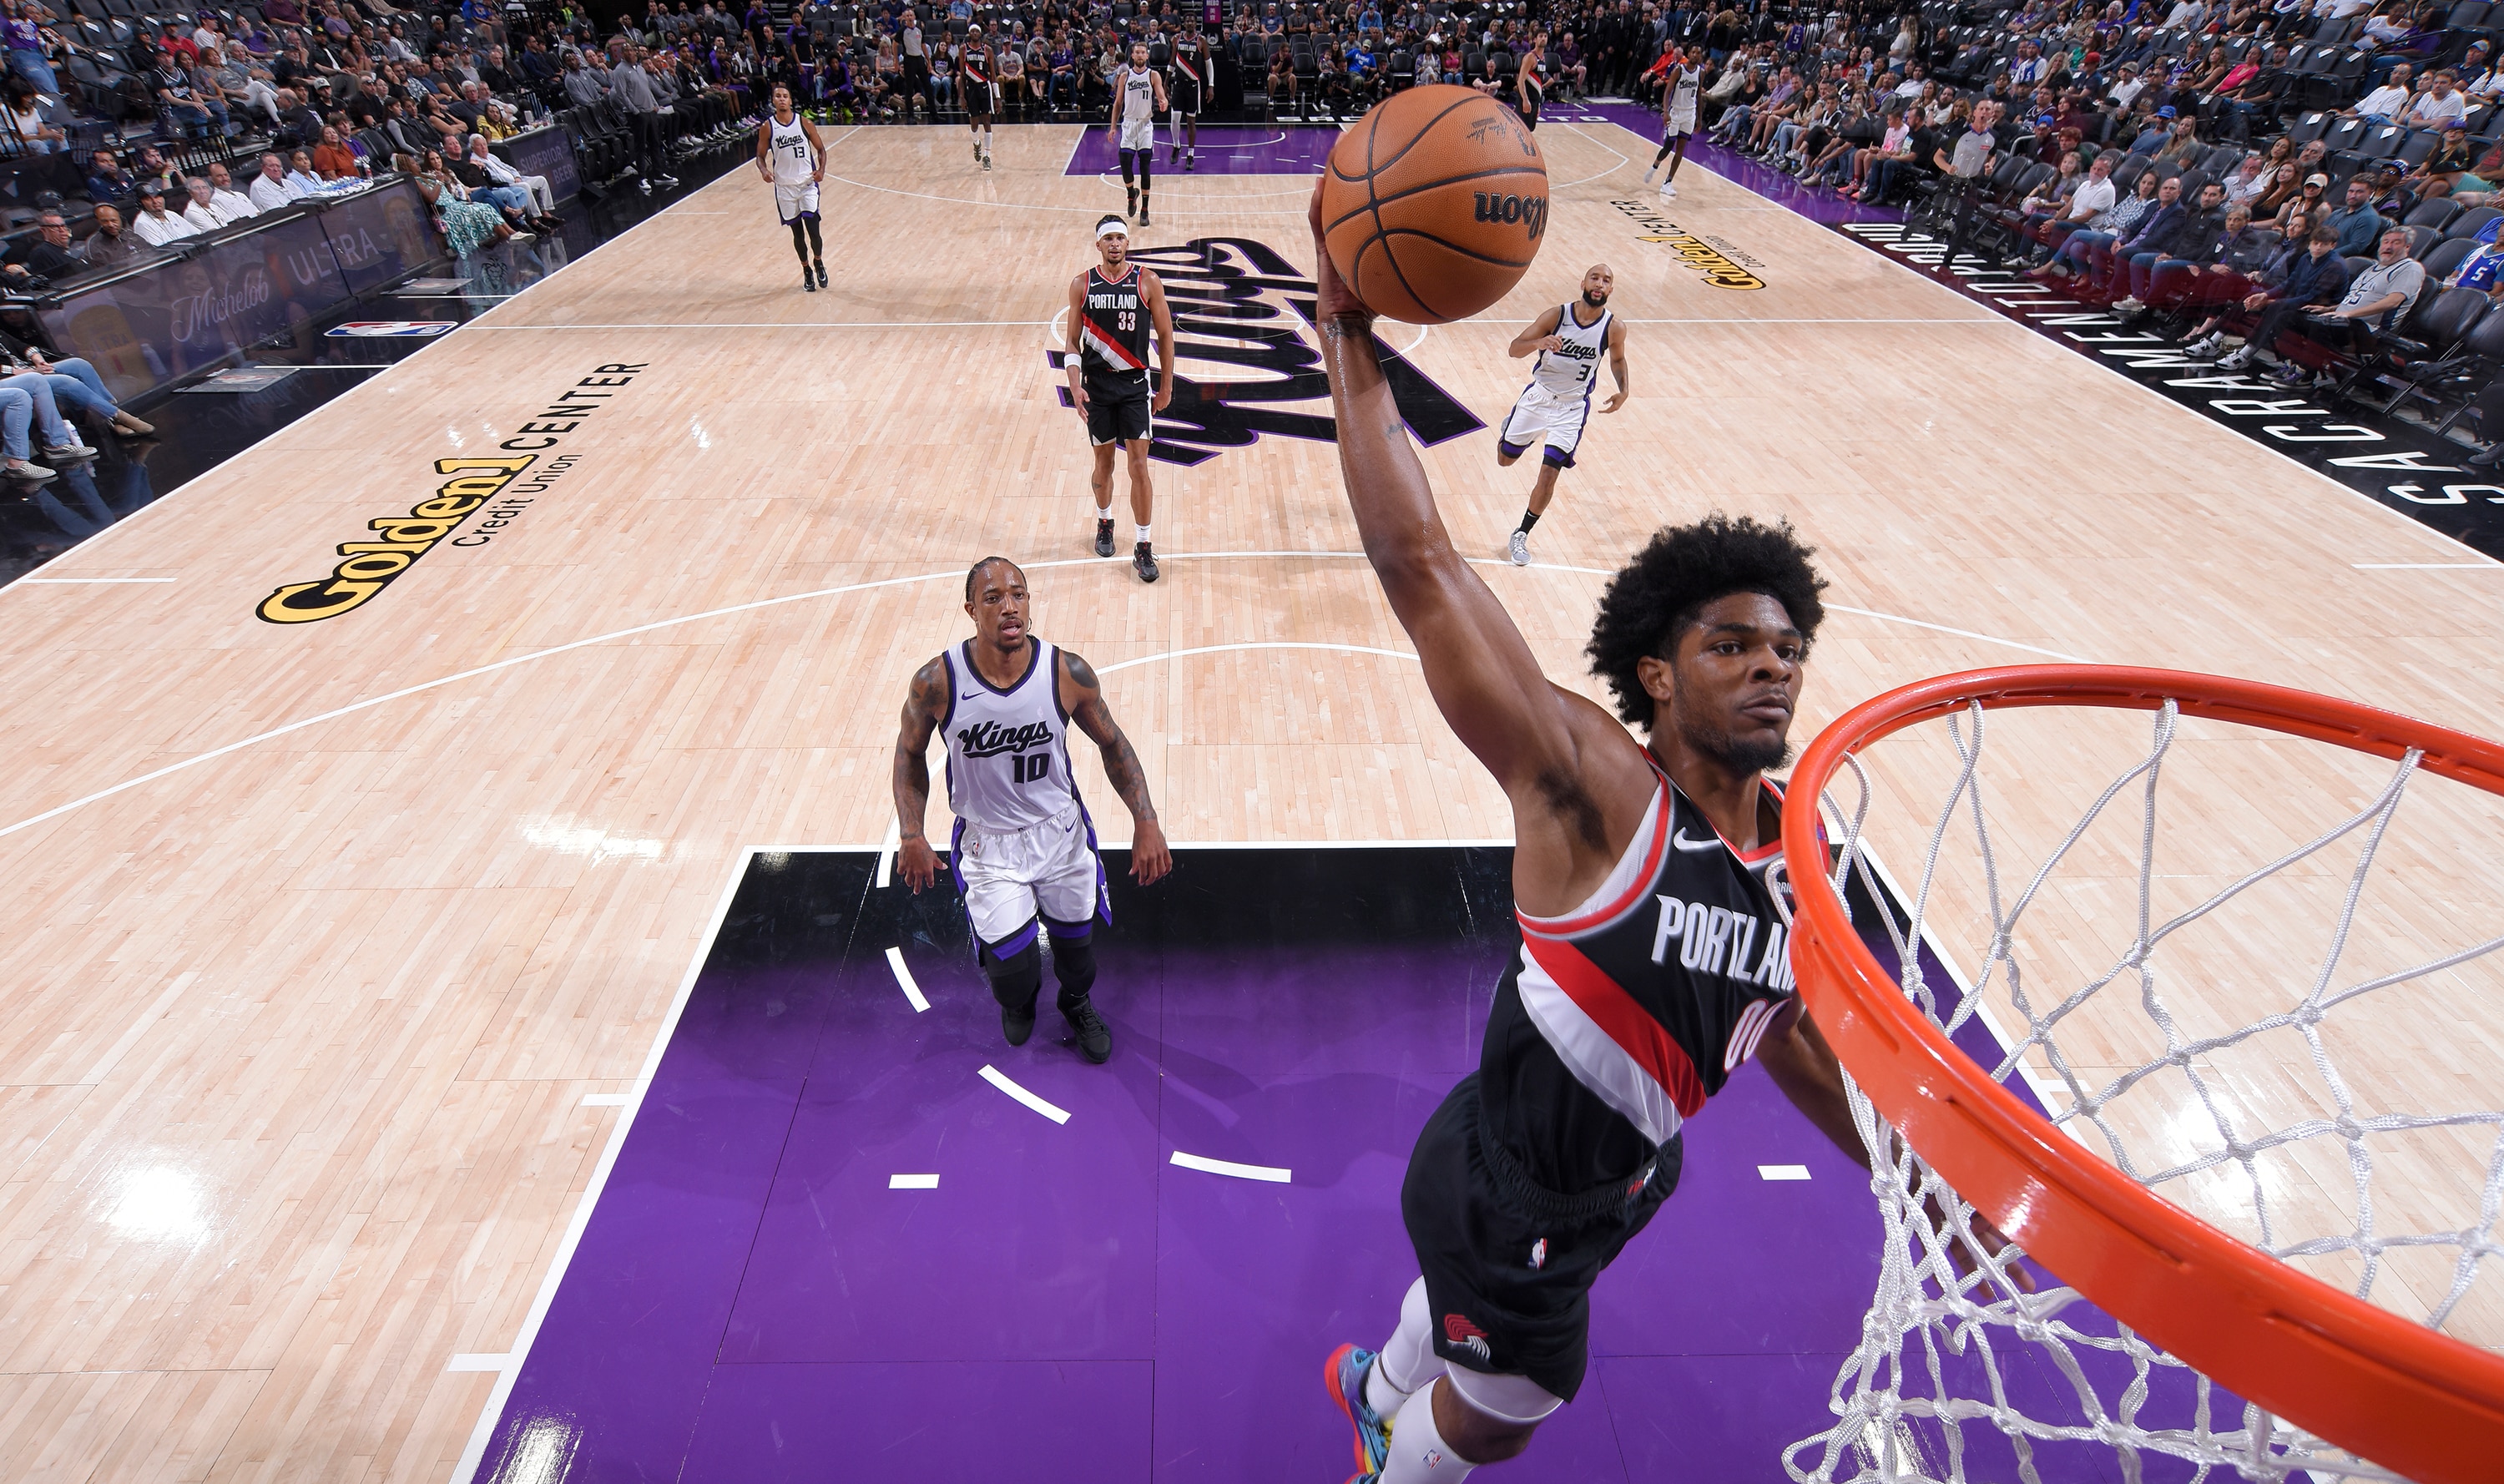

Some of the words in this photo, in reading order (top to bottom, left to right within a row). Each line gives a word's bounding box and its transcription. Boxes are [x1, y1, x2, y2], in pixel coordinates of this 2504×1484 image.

[1189, 52, 1194, 61] 2
[1128, 79, 1149, 91] Kings
[1142, 89, 1149, 100] 11
[775, 134, 804, 149] Kings
[520, 145, 563, 174] SUPERIOR
[792, 146, 805, 159] 13
[553, 164, 575, 184] BEER
[1610, 200, 1687, 235] CENTER
[2471, 266, 2489, 282] 5
[171, 266, 269, 343] Michelob
[287, 227, 381, 285] ULTRA
[1088, 294, 1137, 310] PORTLAND
[1118, 310, 1136, 331] 33
[1553, 337, 1597, 360] Kings
[1575, 364, 1592, 381] 3
[499, 362, 649, 450] CENTER
[452, 497, 535, 547] Credit
[511, 452, 583, 492] Union
[957, 720, 1053, 759] Kings
[1012, 753, 1050, 784] 10
